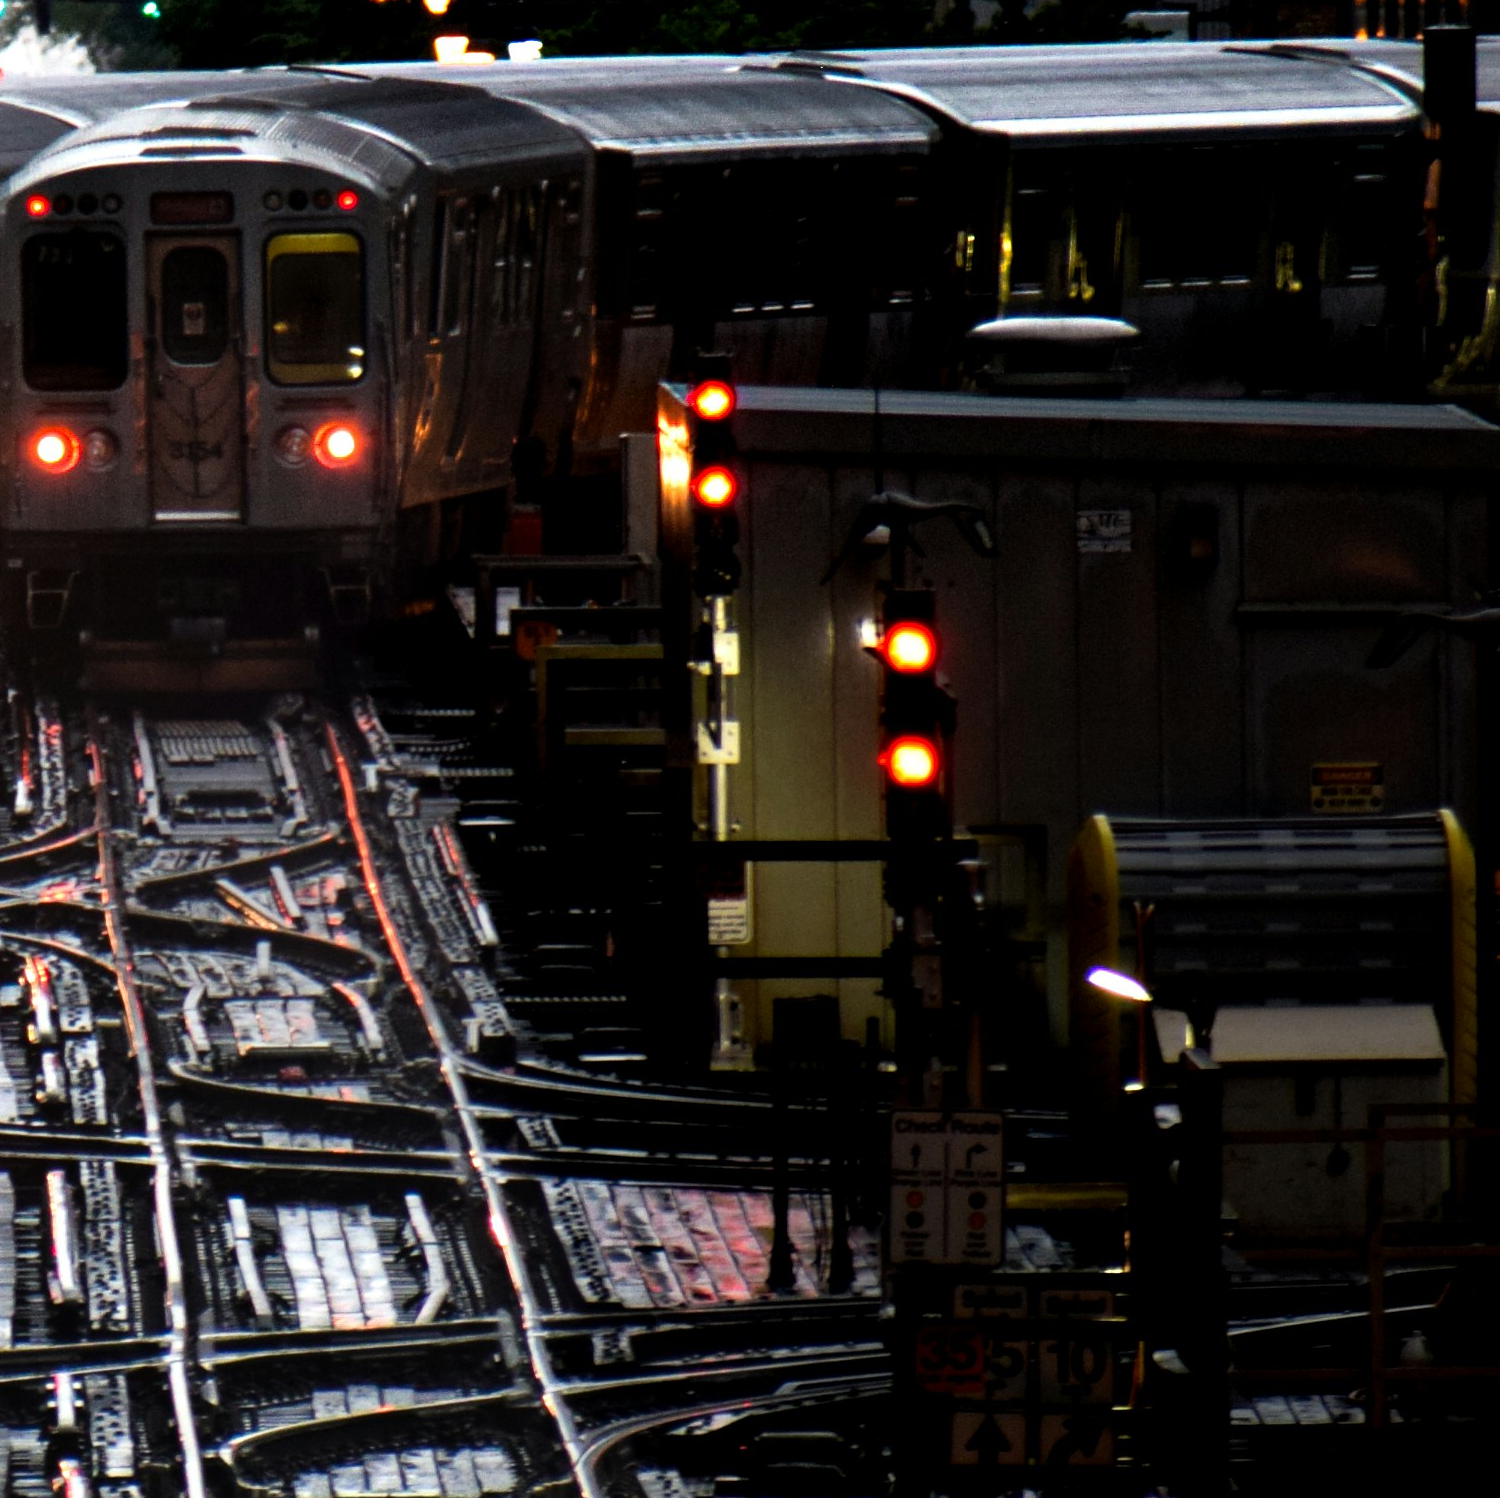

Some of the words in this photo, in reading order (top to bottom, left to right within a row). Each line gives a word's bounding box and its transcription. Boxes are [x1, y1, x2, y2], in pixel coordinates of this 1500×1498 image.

[895, 1119, 946, 1134] Check
[950, 1120, 1001, 1135] Route
[921, 1330, 976, 1370] 35
[1046, 1339, 1107, 1385] 10
